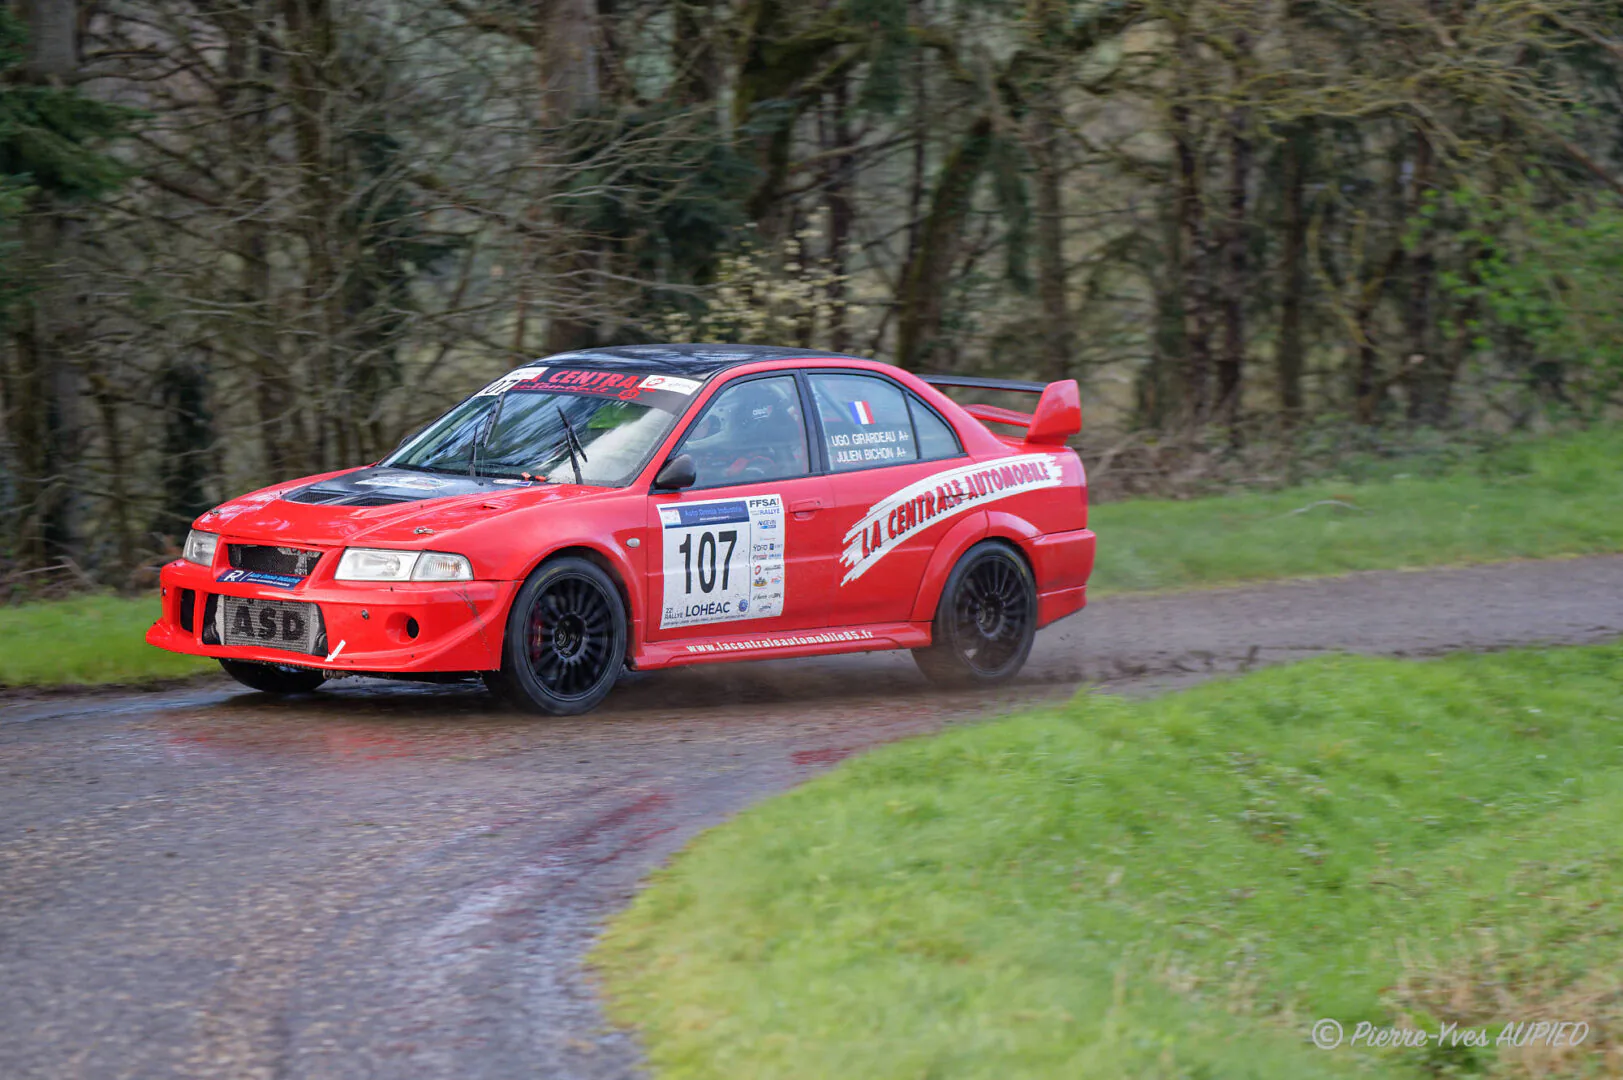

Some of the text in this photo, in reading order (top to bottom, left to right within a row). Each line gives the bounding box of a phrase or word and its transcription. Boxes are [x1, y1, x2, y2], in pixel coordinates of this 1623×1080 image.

[548, 370, 658, 393] CENTRA
[831, 430, 909, 446] UGO GIRARDEAU A+
[837, 446, 907, 463] JULIEN BICHON A+
[749, 498, 776, 508] FFSA
[861, 461, 1051, 559] LA CENTRALE AUTOMOBILE
[679, 530, 738, 594] 107
[685, 601, 731, 617] LOHÉAC
[231, 605, 305, 641] ASD
